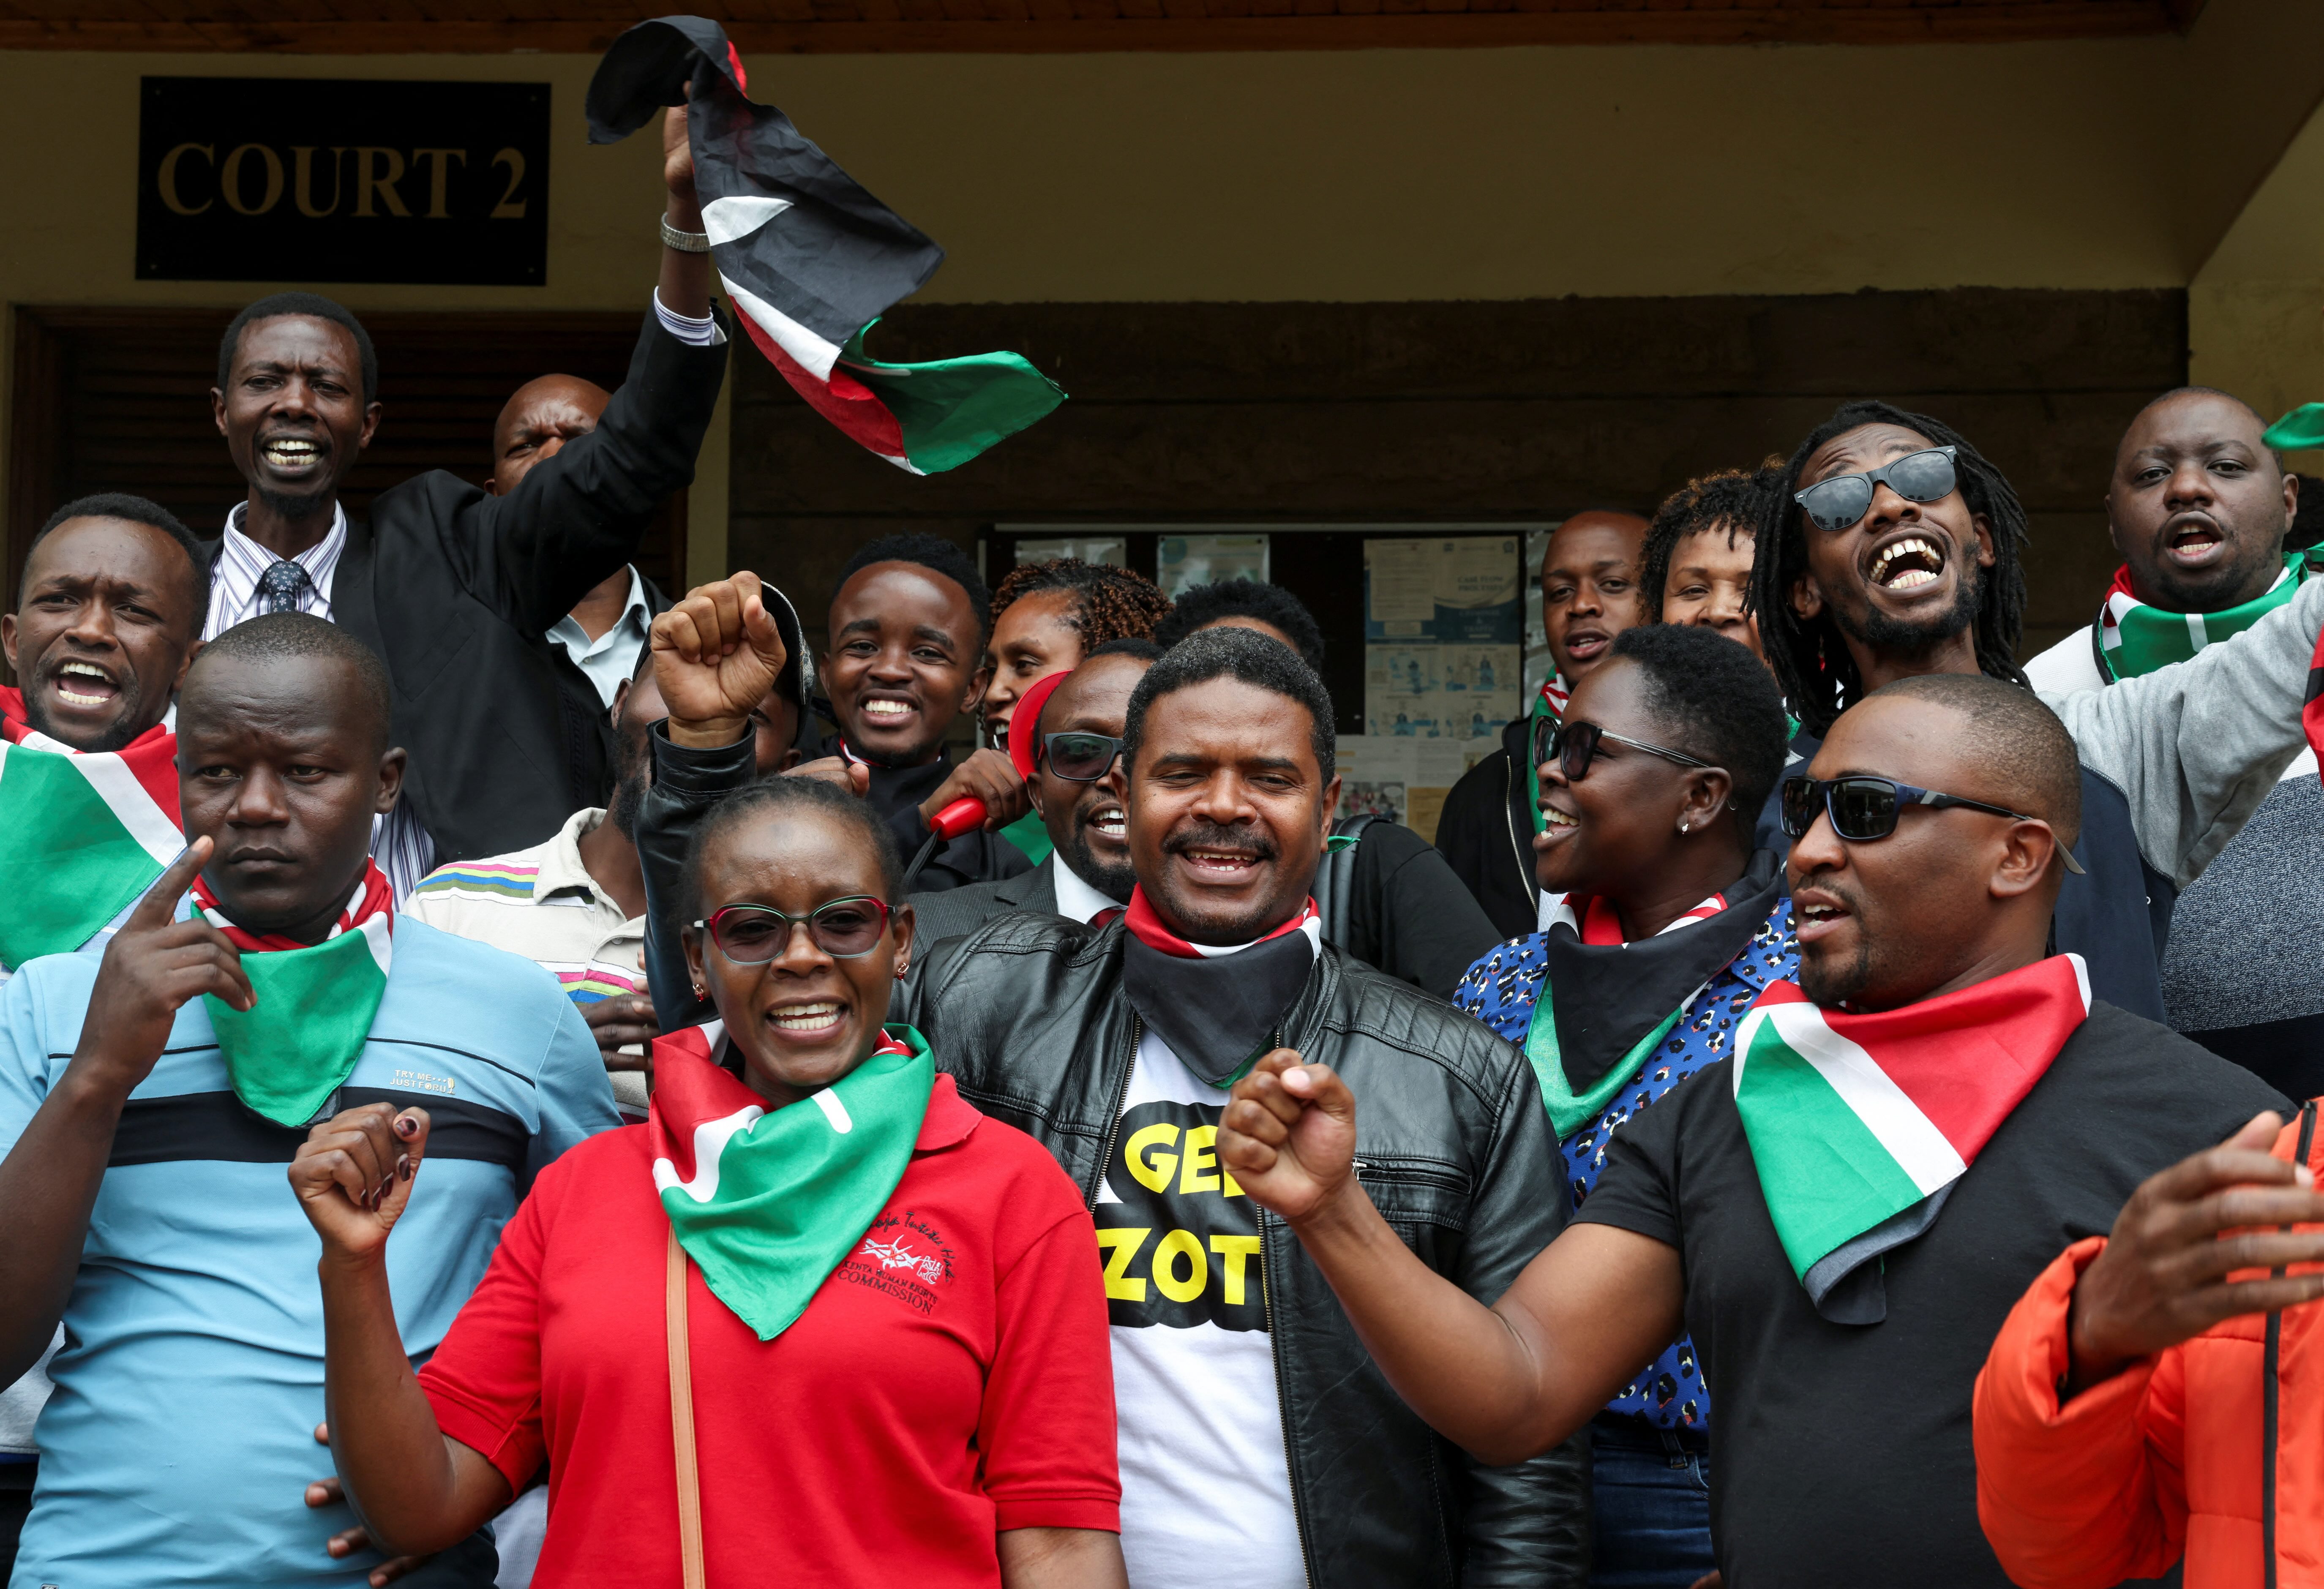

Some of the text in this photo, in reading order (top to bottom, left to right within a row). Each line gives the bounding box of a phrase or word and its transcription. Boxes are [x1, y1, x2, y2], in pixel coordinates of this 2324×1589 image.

[158, 142, 528, 218] COURT 2
[390, 1078, 416, 1087] JUST
[395, 1069, 415, 1079] TRY
[843, 1260, 873, 1273] KENYA
[909, 1283, 938, 1305] RIGHTS
[1096, 1227, 1260, 1306] ZOT
[838, 1270, 933, 1315] COMMISSION
